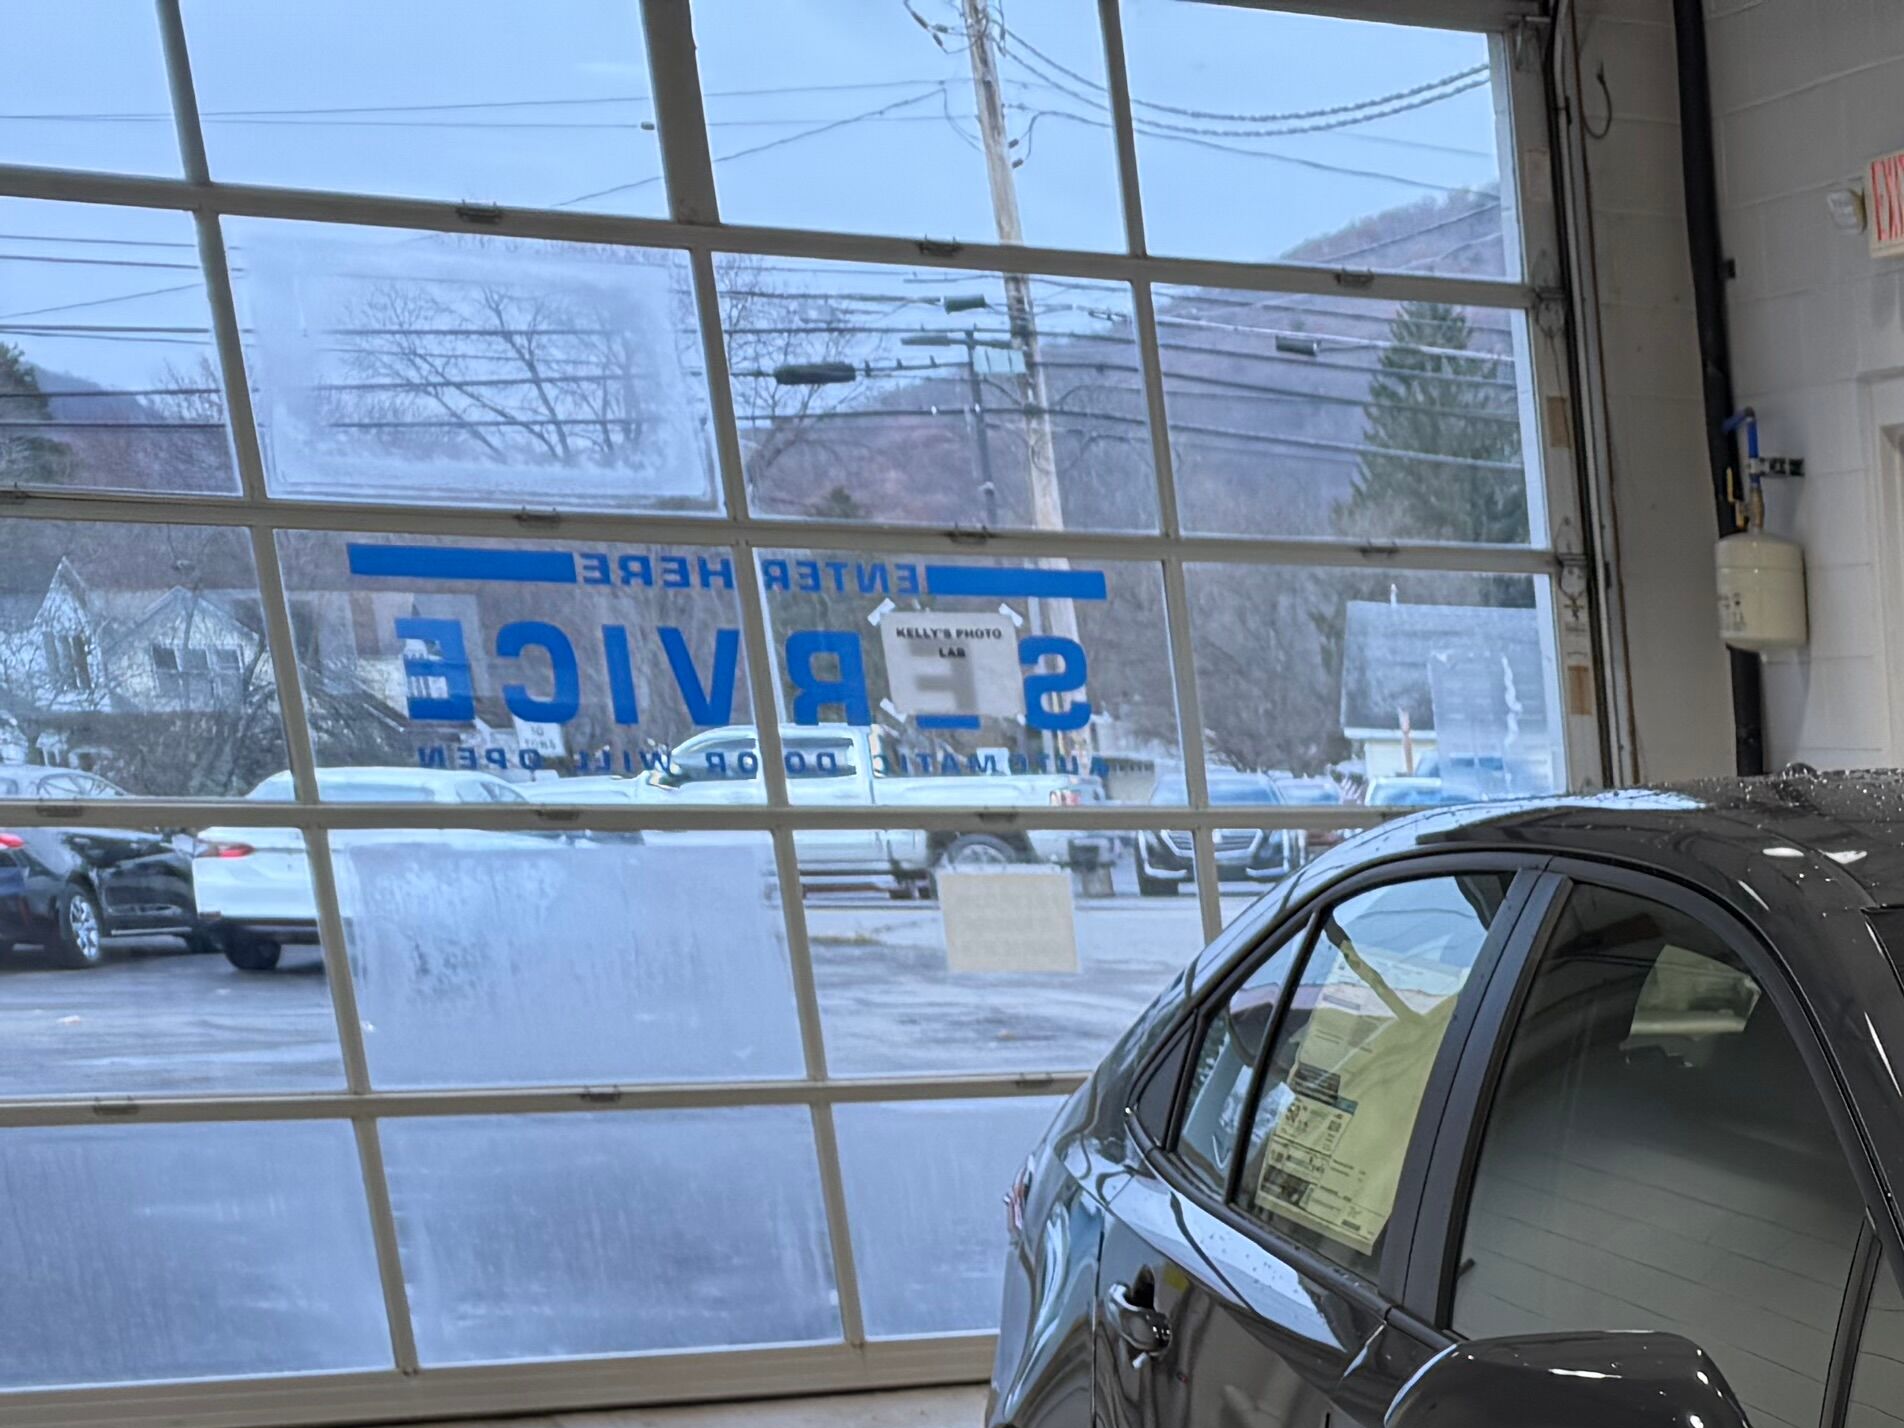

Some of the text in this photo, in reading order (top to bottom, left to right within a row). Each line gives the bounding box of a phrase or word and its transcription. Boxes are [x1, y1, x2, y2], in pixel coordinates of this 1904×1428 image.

[896, 627, 1002, 640] KELLY'S PHOTO
[939, 647, 966, 659] LAB
